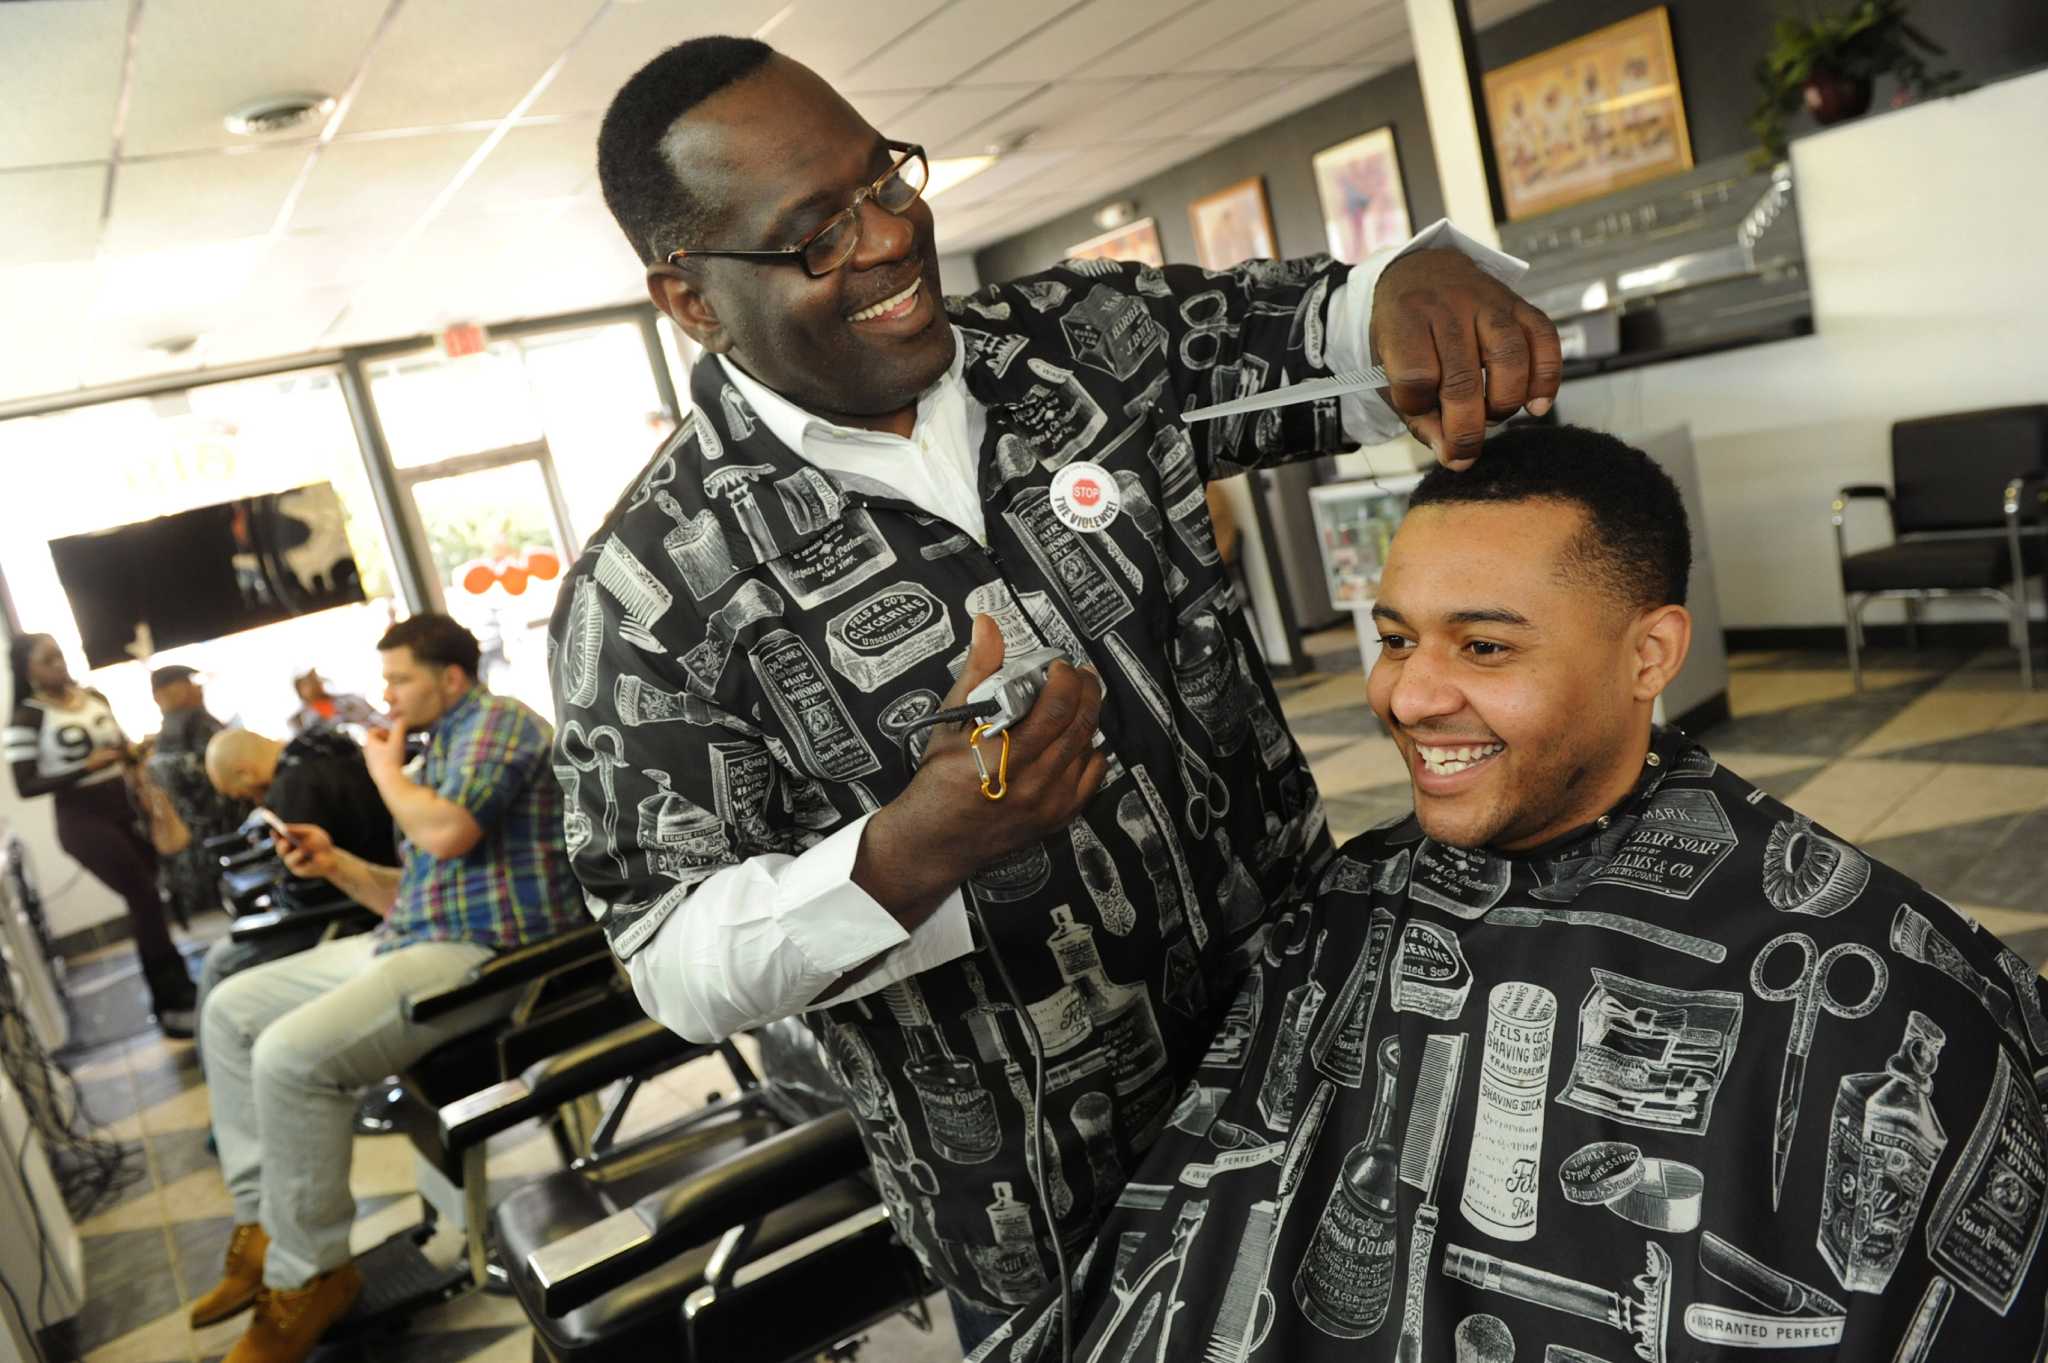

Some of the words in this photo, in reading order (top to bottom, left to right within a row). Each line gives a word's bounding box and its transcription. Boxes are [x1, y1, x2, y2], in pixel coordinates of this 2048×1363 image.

[1073, 487, 1099, 498] STOP
[1054, 496, 1072, 518] THE
[1070, 500, 1118, 529] VIOLENCE!
[849, 609, 872, 629] FELS
[871, 603, 882, 614] &
[883, 595, 907, 608] CO'S
[849, 598, 926, 641] GLYCERINE
[1493, 1020, 1521, 1043] FELS
[1487, 1030, 1531, 1063] SHAVING
[1481, 1084, 1519, 1111] SHAVING
[1564, 1166, 1591, 1182] STROP
[1590, 1151, 1638, 1182] DRESSING
[1776, 1326, 1838, 1340] PERFECT
